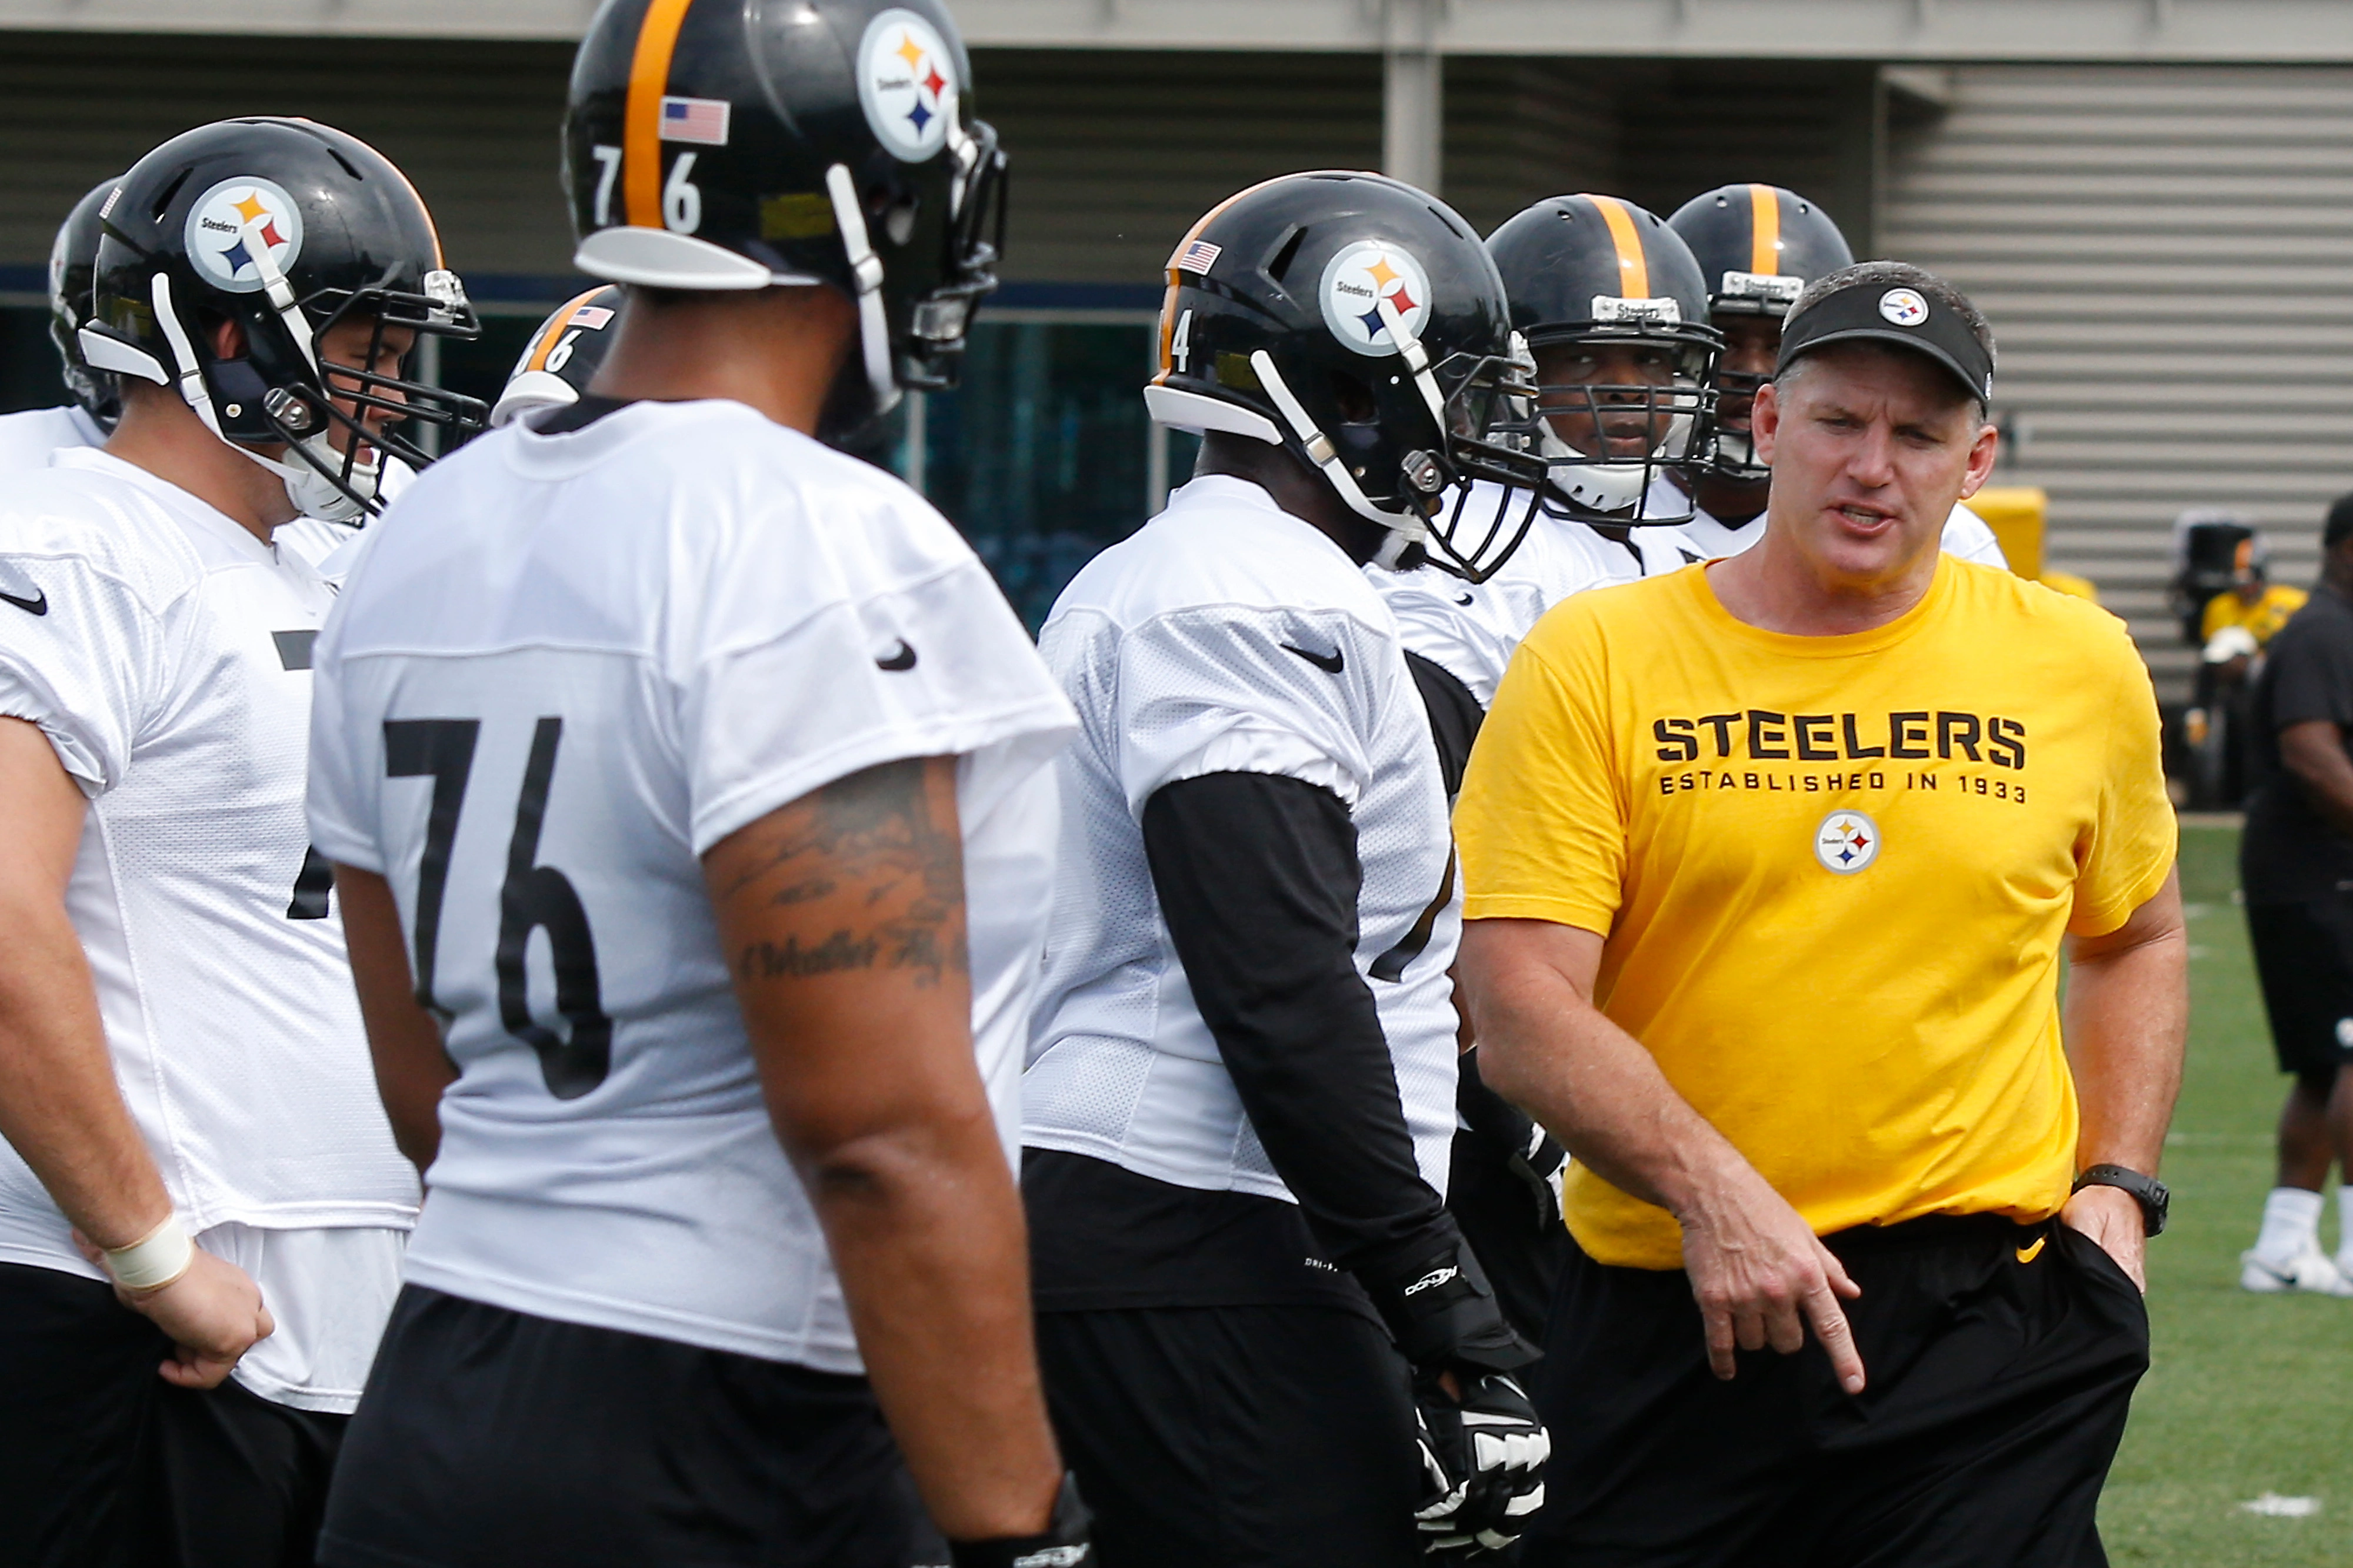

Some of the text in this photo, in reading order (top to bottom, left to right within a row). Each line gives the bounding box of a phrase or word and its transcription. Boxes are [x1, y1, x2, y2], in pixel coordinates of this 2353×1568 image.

[593, 145, 701, 234] 76
[201, 217, 238, 234] Steelers
[1337, 281, 1373, 298] Steelers
[1653, 709, 2025, 770] STEELERS
[1660, 771, 2025, 804] ESTABLISHED IN 1933
[383, 717, 612, 1100] 76
